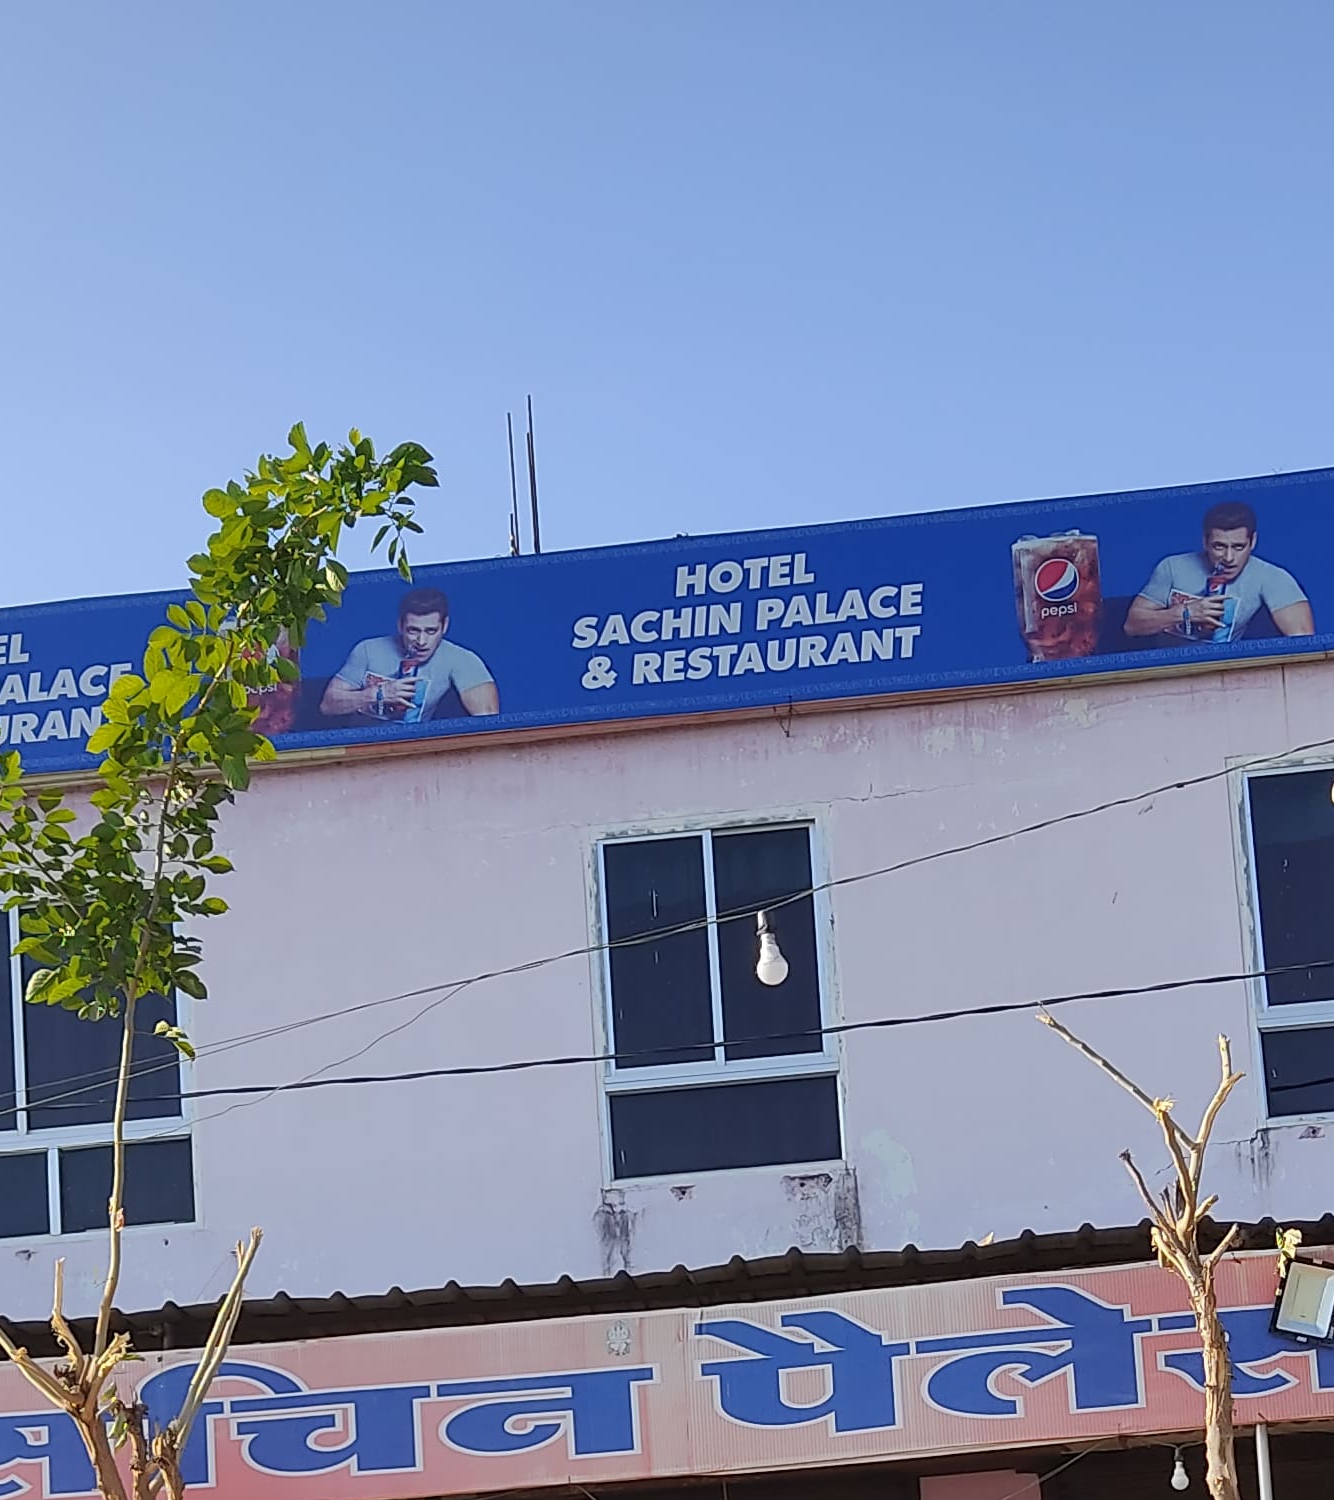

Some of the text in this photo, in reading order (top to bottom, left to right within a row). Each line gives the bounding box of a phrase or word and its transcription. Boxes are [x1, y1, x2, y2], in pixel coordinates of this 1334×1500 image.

[676, 553, 815, 597] HOTEL
[572, 583, 924, 648] SACHIN PALACE
[1041, 602, 1077, 619] pepsi
[581, 656, 616, 689] &
[632, 625, 921, 684] RESTAURANT
